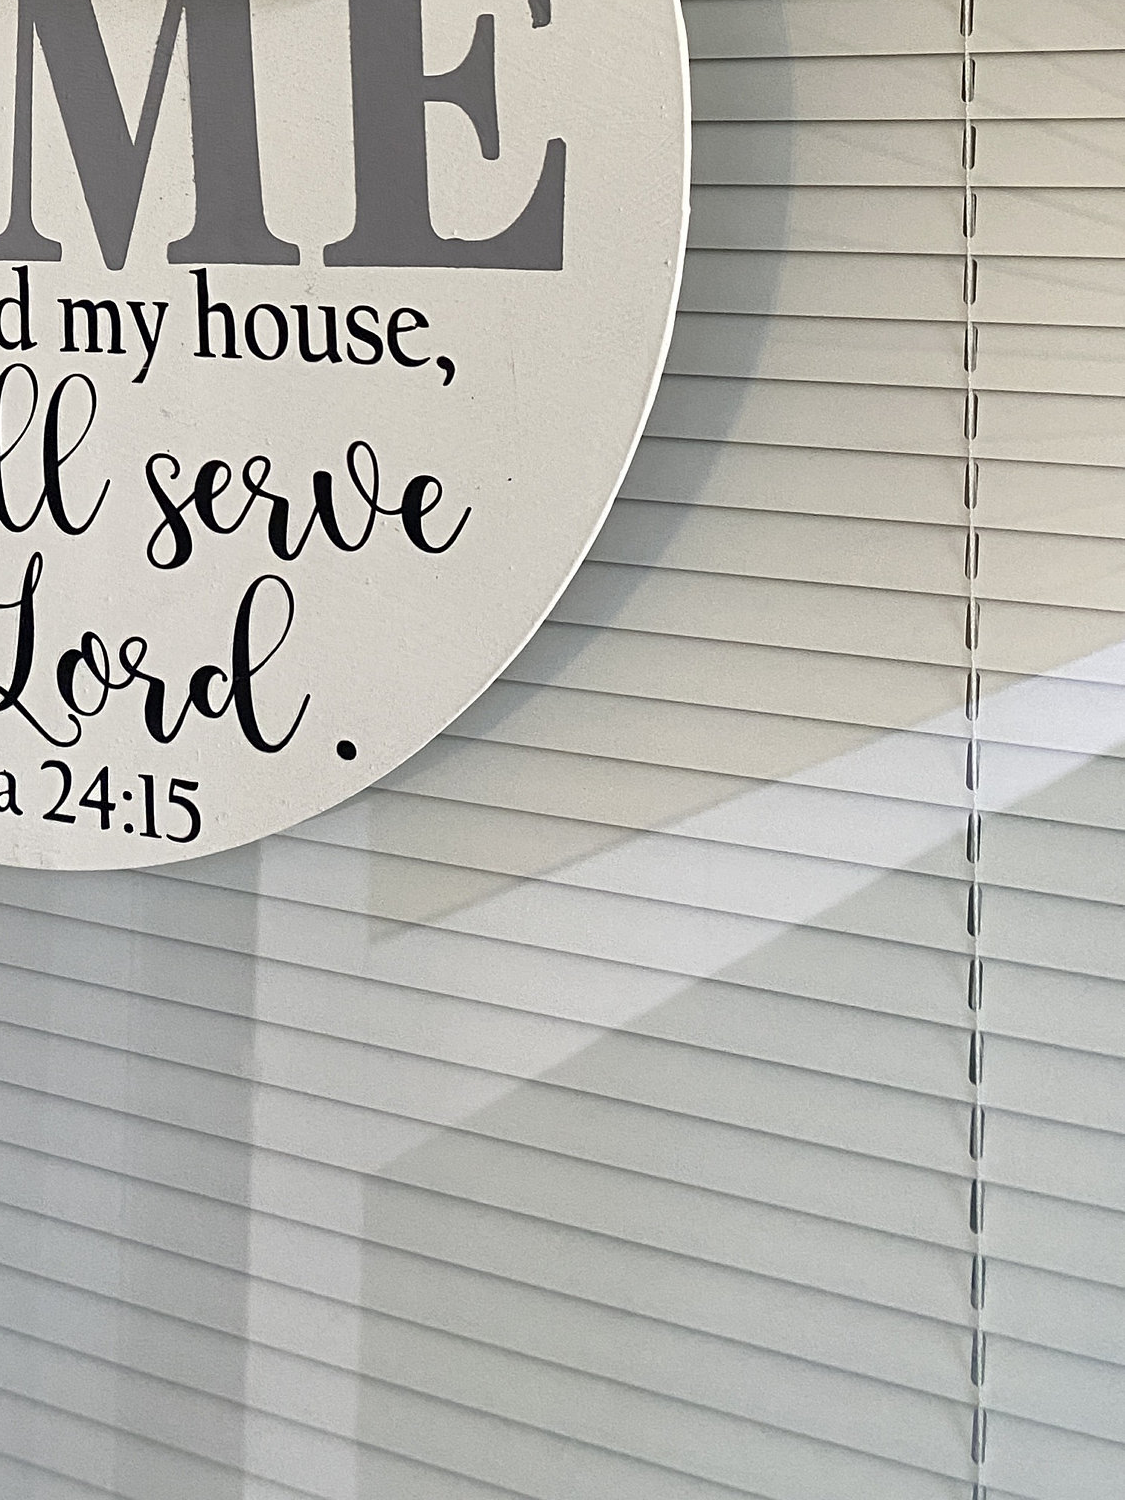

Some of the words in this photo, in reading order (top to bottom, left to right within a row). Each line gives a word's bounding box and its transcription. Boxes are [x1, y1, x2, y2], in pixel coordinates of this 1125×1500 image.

[56, 298, 169, 384] my
[188, 267, 457, 387] house,
[145, 440, 473, 570] serve
[40, 759, 202, 844] 24:15
